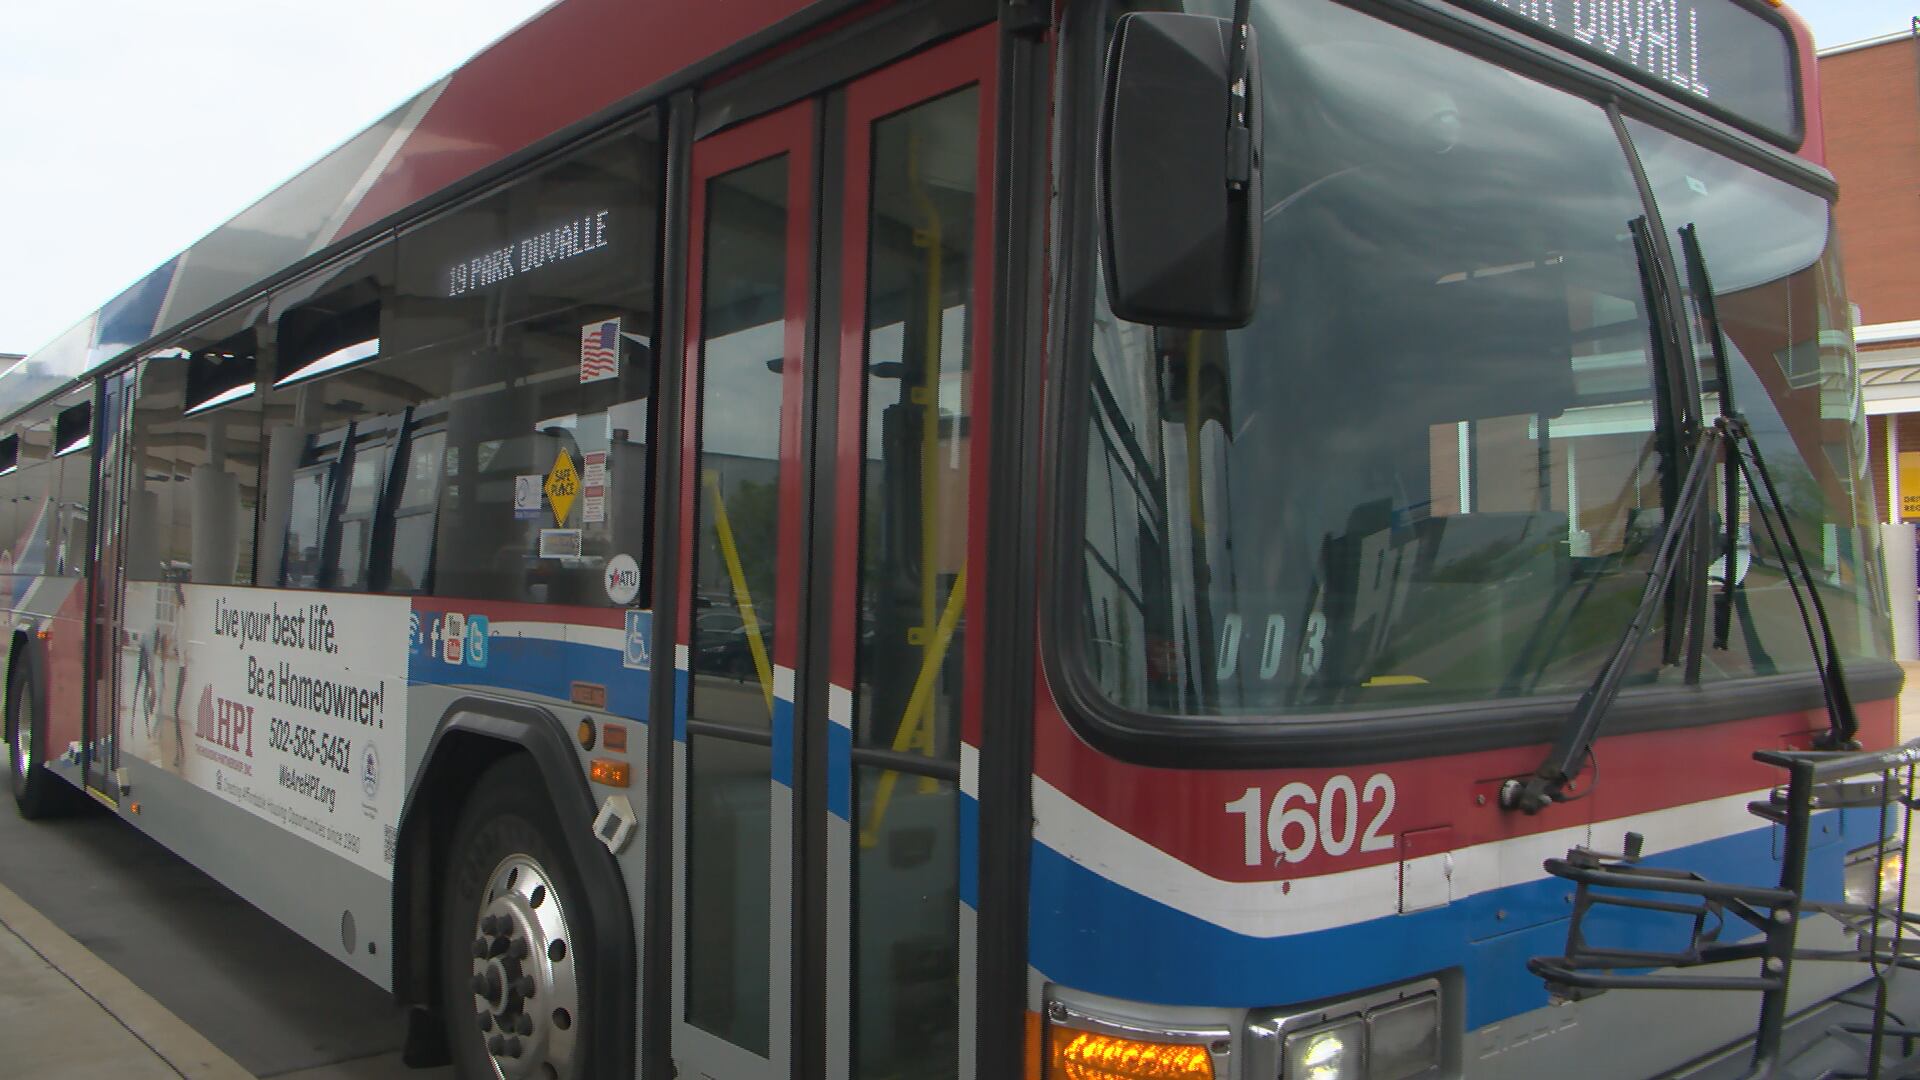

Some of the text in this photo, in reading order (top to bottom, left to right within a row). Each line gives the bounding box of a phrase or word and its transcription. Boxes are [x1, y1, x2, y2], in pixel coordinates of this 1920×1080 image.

[449, 210, 609, 296] 19 PARK DUVALLE
[551, 482, 575, 496] PLACE
[555, 468, 571, 481] SAFE
[618, 570, 637, 586] ATU
[214, 597, 338, 654] Live your best life.
[247, 655, 385, 729] Be a Homeowner!
[216, 697, 255, 757] HPI
[269, 717, 353, 774] 502-585-5451
[279, 763, 336, 813] WeAreHPI.org
[1225, 772, 1397, 867] 1602
